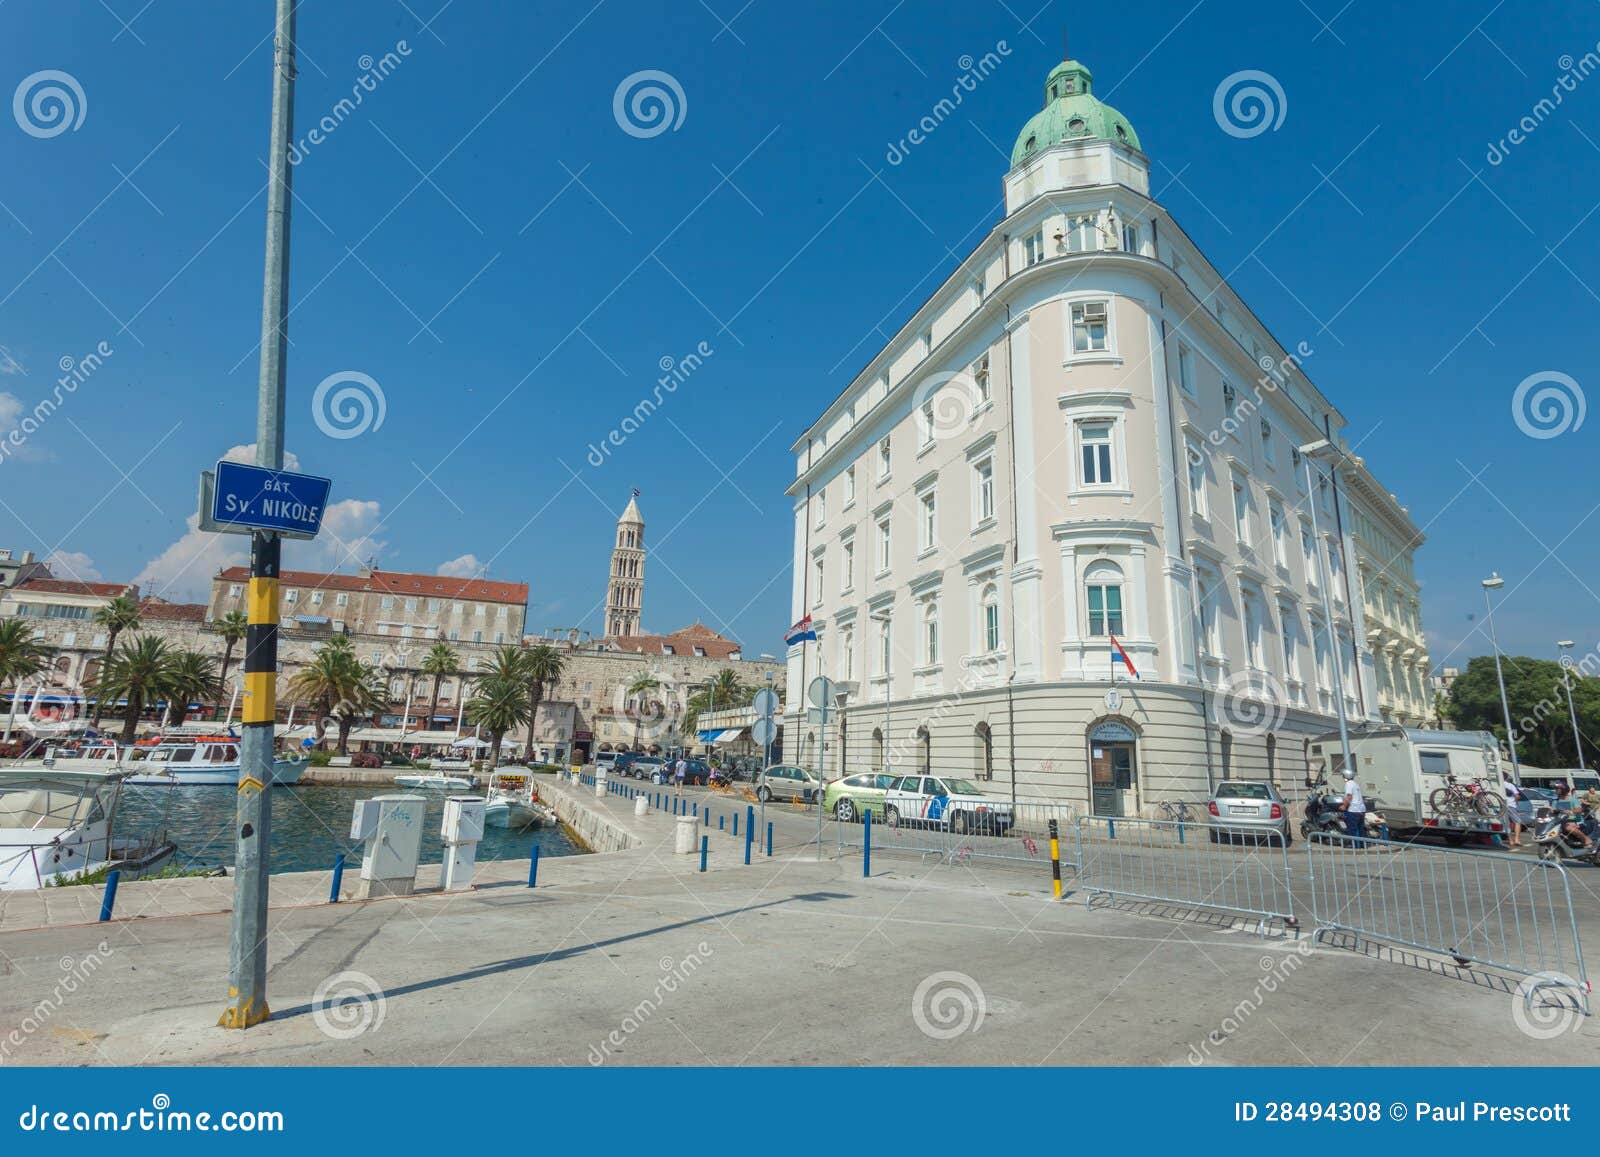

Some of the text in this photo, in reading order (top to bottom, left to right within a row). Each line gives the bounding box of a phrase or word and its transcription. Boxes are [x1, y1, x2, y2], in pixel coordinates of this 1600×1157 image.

[264, 480, 291, 492] GAT
[225, 493, 319, 523] Sv. NIKOLE
